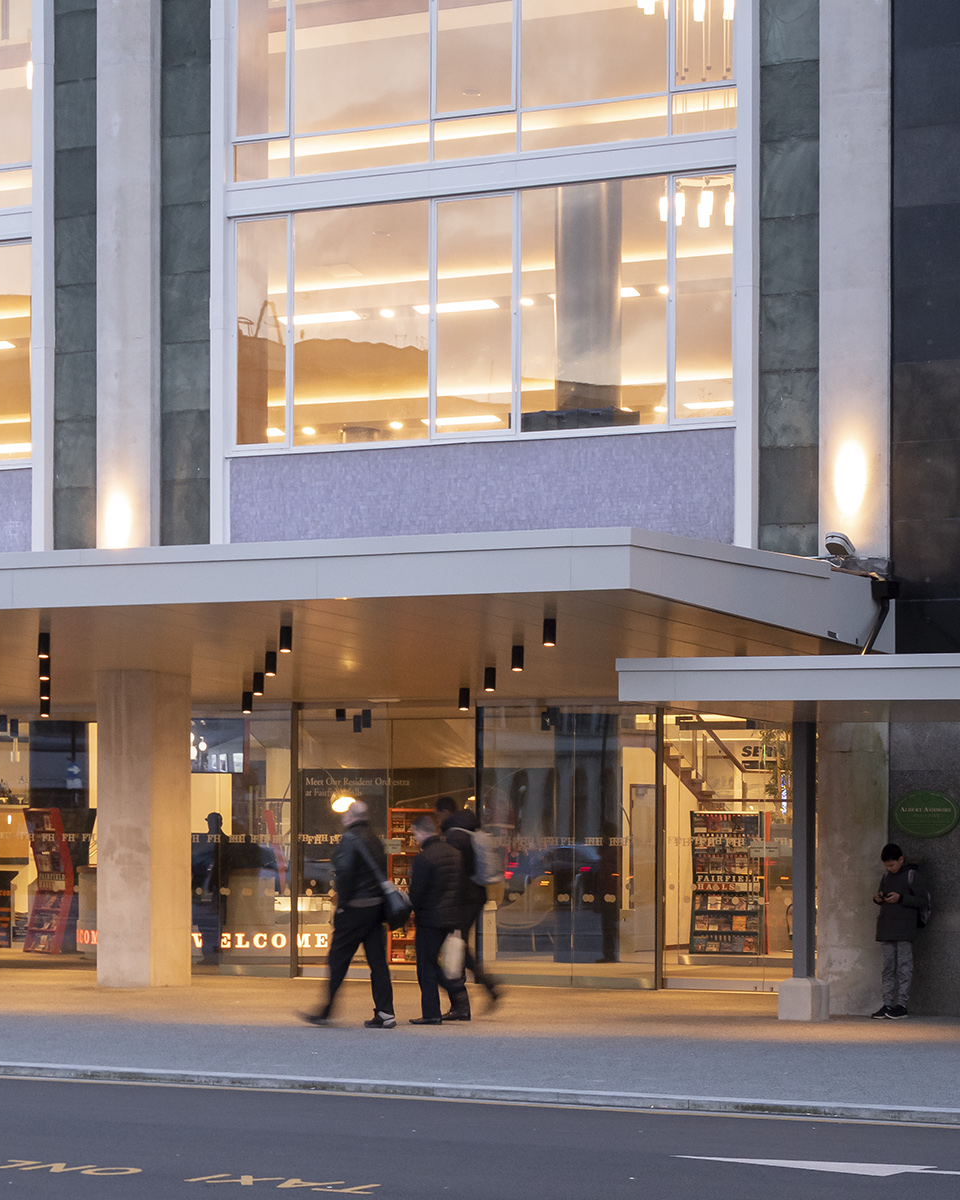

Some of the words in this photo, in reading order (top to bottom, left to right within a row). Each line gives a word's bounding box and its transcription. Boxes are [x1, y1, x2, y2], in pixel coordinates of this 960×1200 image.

[305, 777, 324, 786] Meet
[325, 776, 341, 786] Our
[343, 776, 373, 786] Resident
[42, 833, 55, 841] FH
[62, 833, 75, 841] FH
[207, 835, 221, 843] FH
[184, 1173, 381, 1194] TAXI
